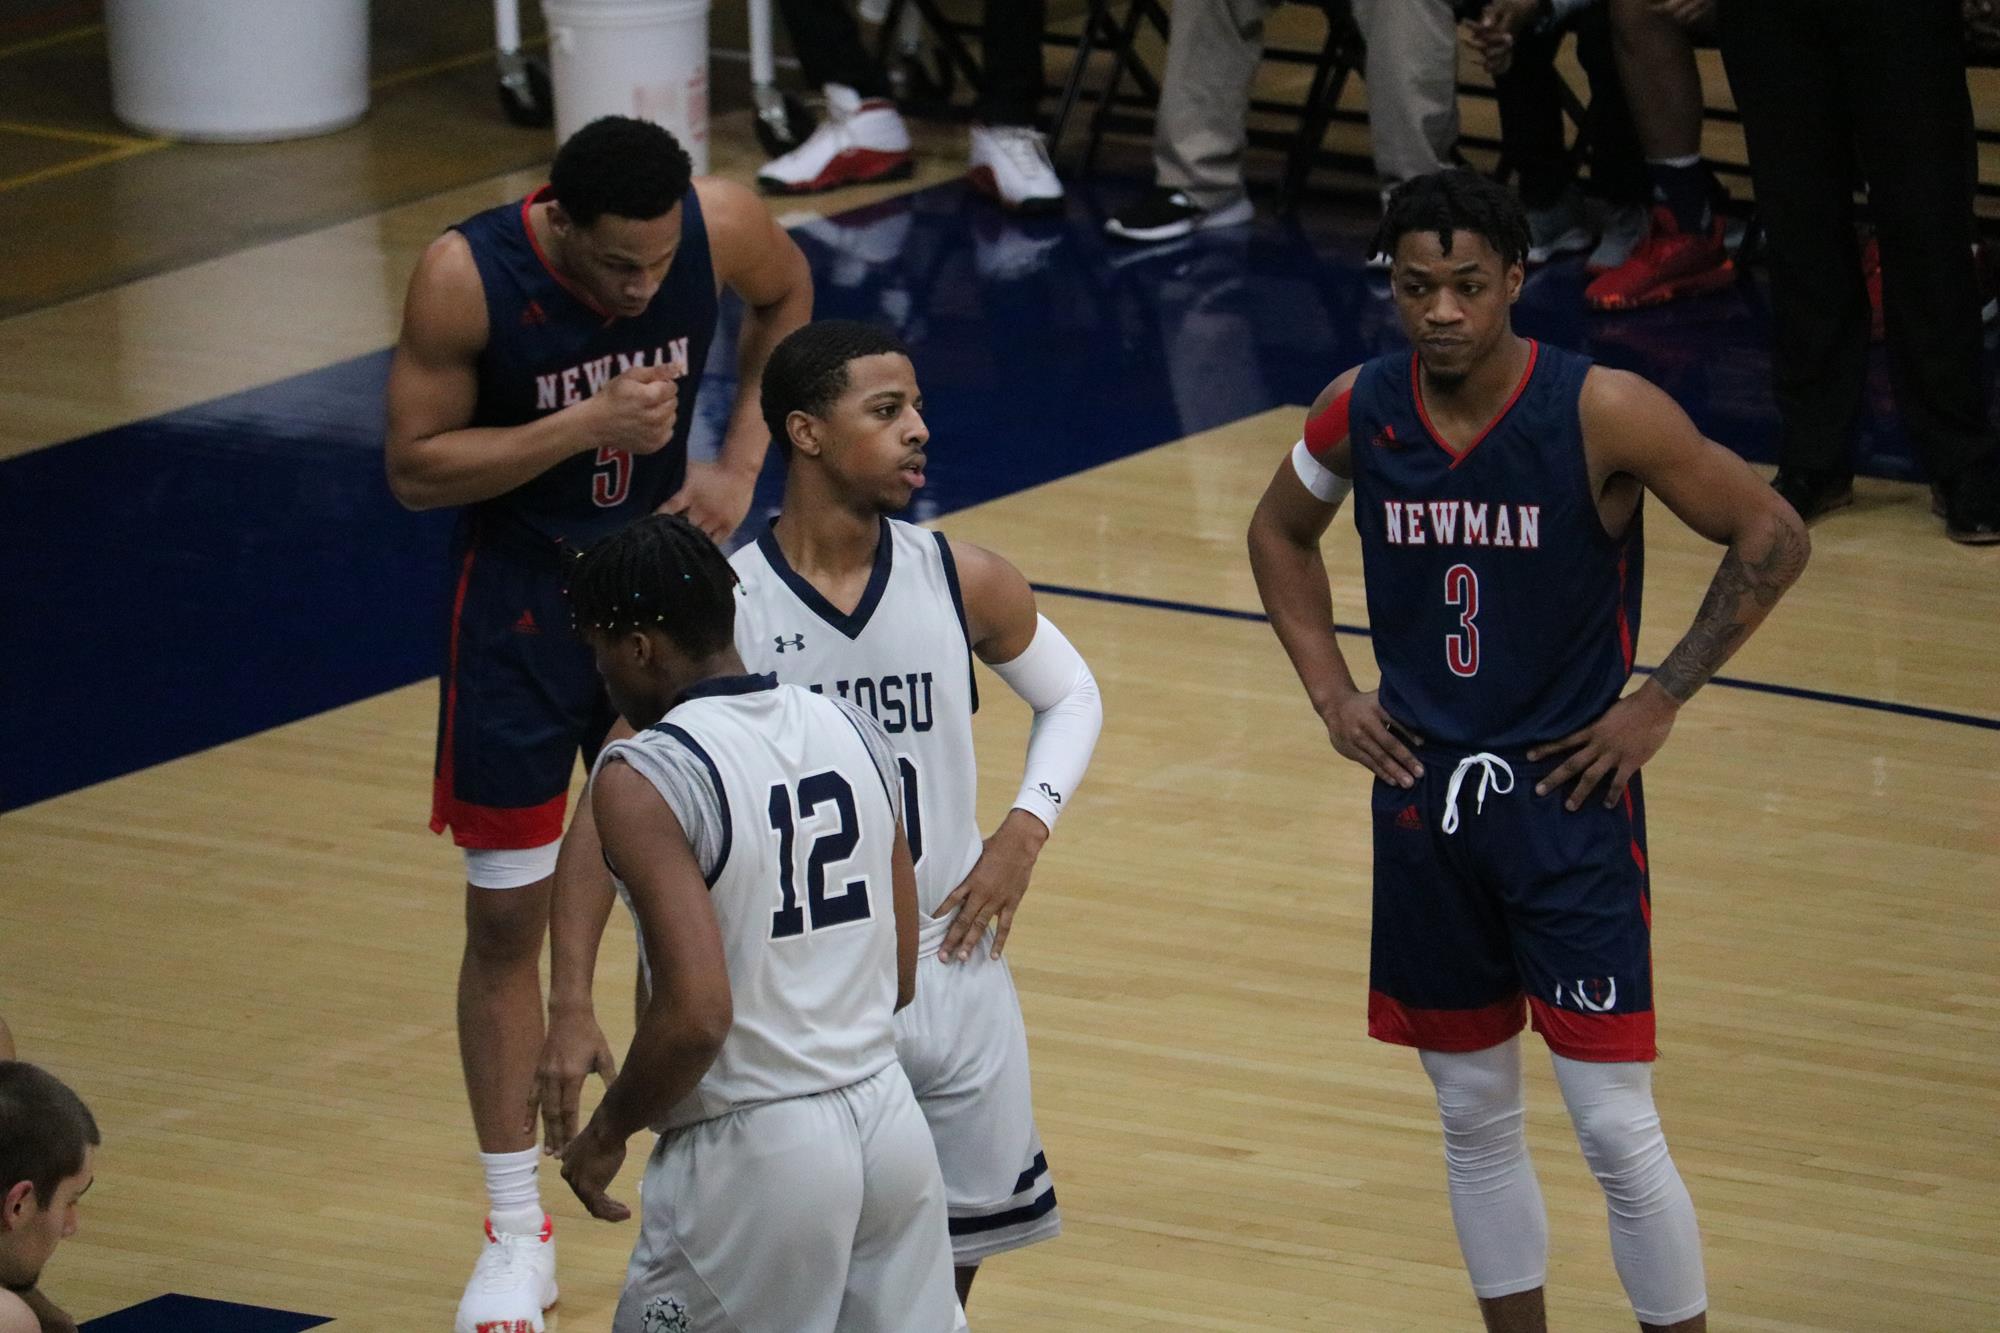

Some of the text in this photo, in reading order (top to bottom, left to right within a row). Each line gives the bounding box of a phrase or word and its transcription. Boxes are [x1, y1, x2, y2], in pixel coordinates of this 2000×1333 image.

[1384, 501, 1540, 548] NEWMAN
[1445, 563, 1479, 677] 3
[809, 672, 933, 733] OSU
[768, 767, 876, 941] 12
